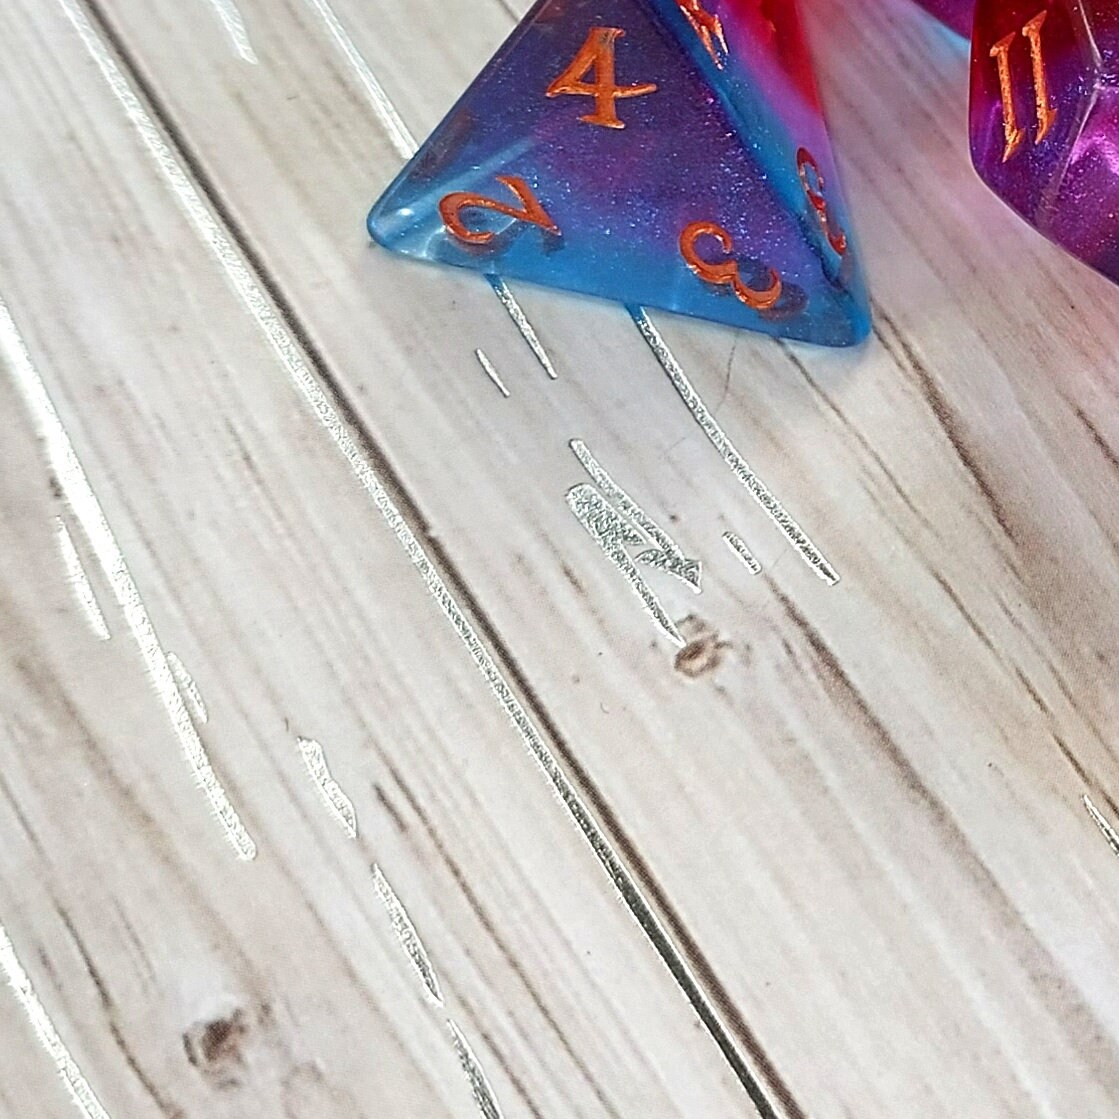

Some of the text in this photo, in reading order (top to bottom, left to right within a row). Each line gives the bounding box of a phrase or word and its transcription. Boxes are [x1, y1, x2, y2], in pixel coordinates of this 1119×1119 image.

[546, 26, 657, 129] 4
[990, 10, 1057, 163] 11
[679, 221, 782, 310] 3
